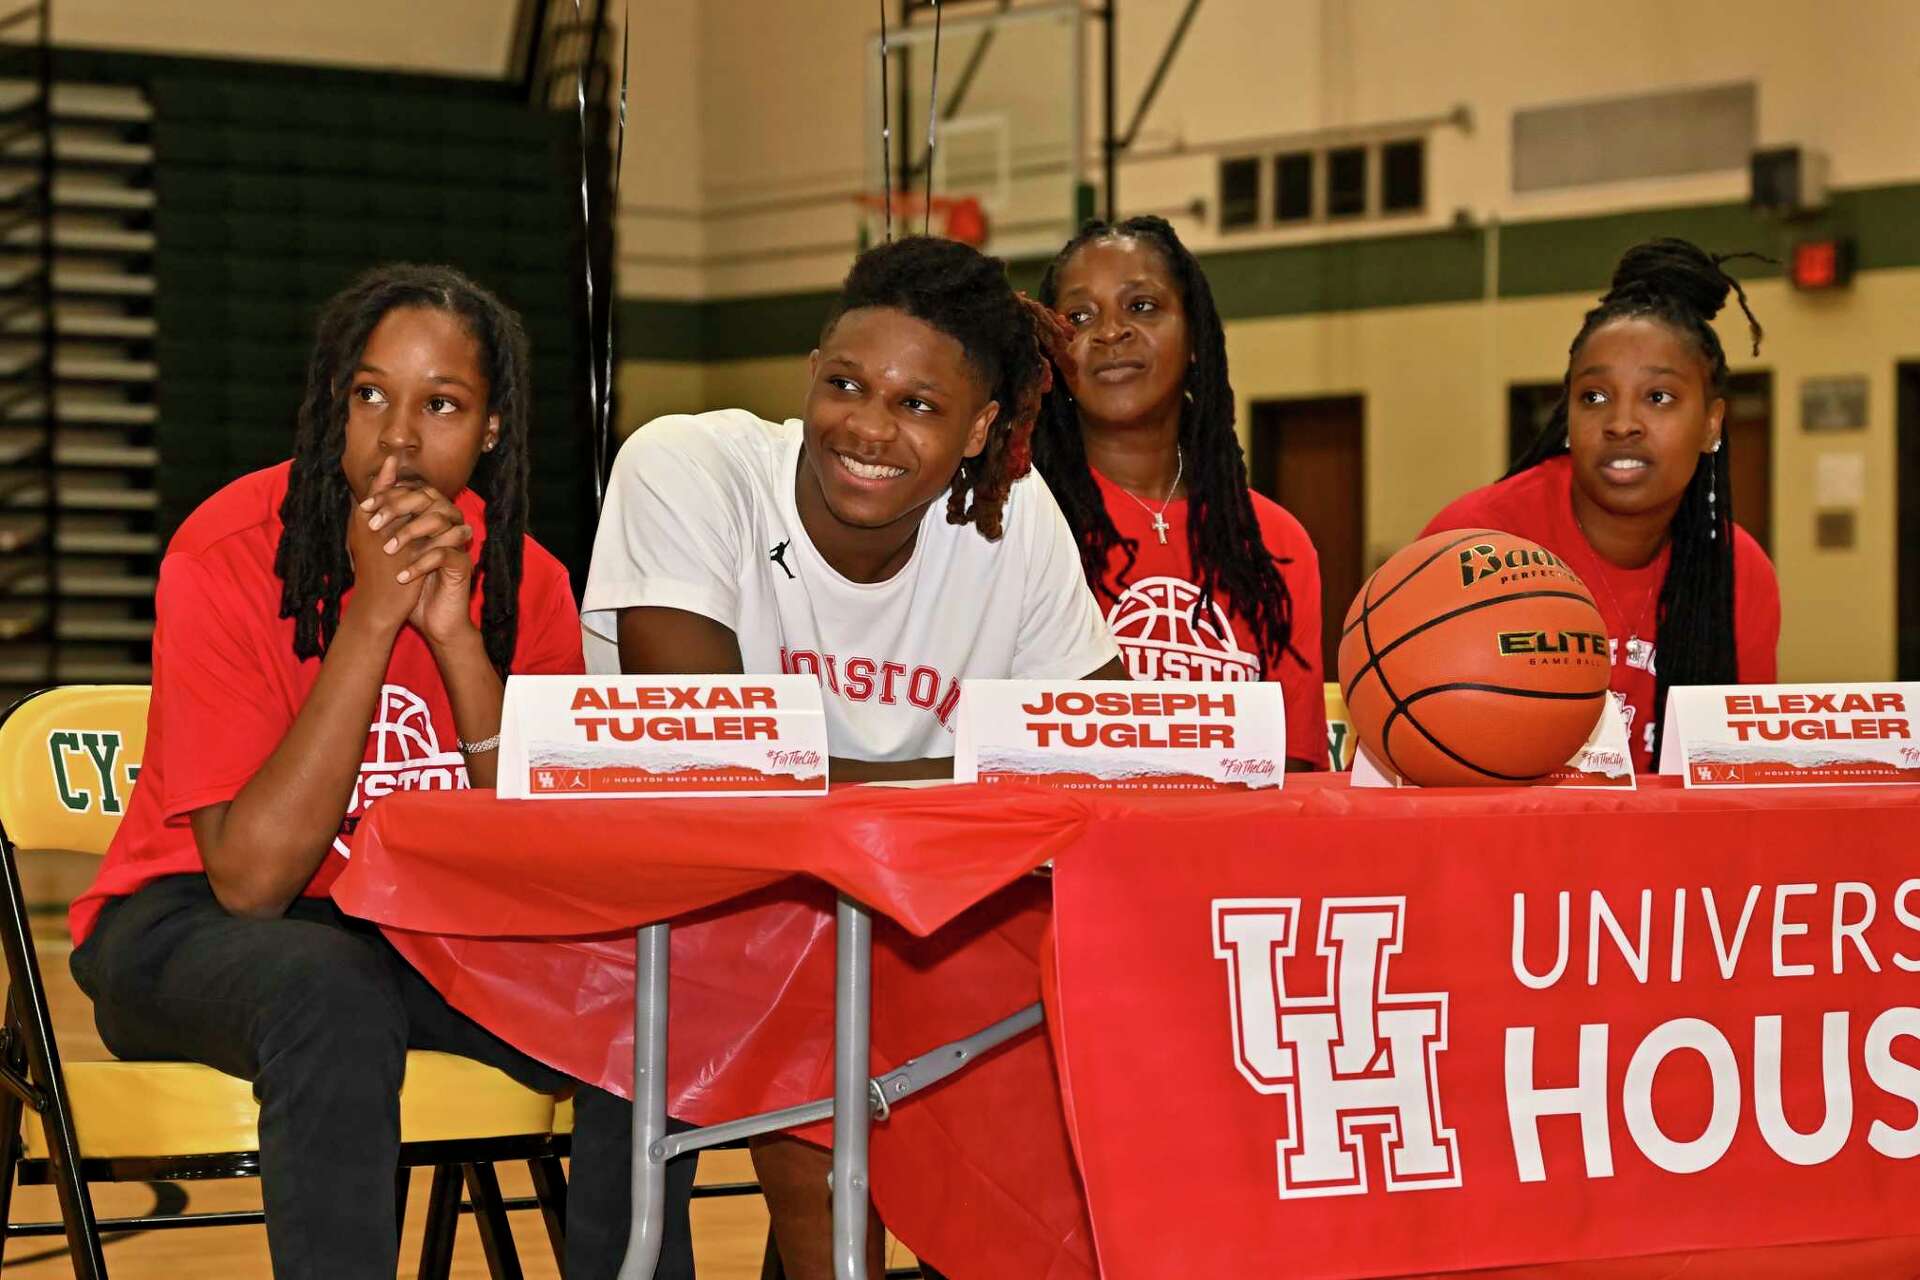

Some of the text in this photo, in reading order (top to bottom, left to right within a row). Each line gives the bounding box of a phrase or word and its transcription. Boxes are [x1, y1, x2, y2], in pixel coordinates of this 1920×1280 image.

[1459, 543, 1568, 588] Bad
[1498, 631, 1609, 657] ELITE
[1529, 657, 1569, 666] GAME
[570, 687, 778, 710] ALEXAR
[1021, 692, 1236, 717] JOSEPH
[1725, 693, 1906, 715] ELEXAR
[574, 716, 779, 742] TUGLER
[1026, 722, 1235, 749] TUGLER
[1727, 718, 1911, 742] TUGLER
[702, 775, 767, 783] BASKETBALL
[1211, 895, 1462, 1200] UH
[1505, 1007, 1920, 1183] HOUS
